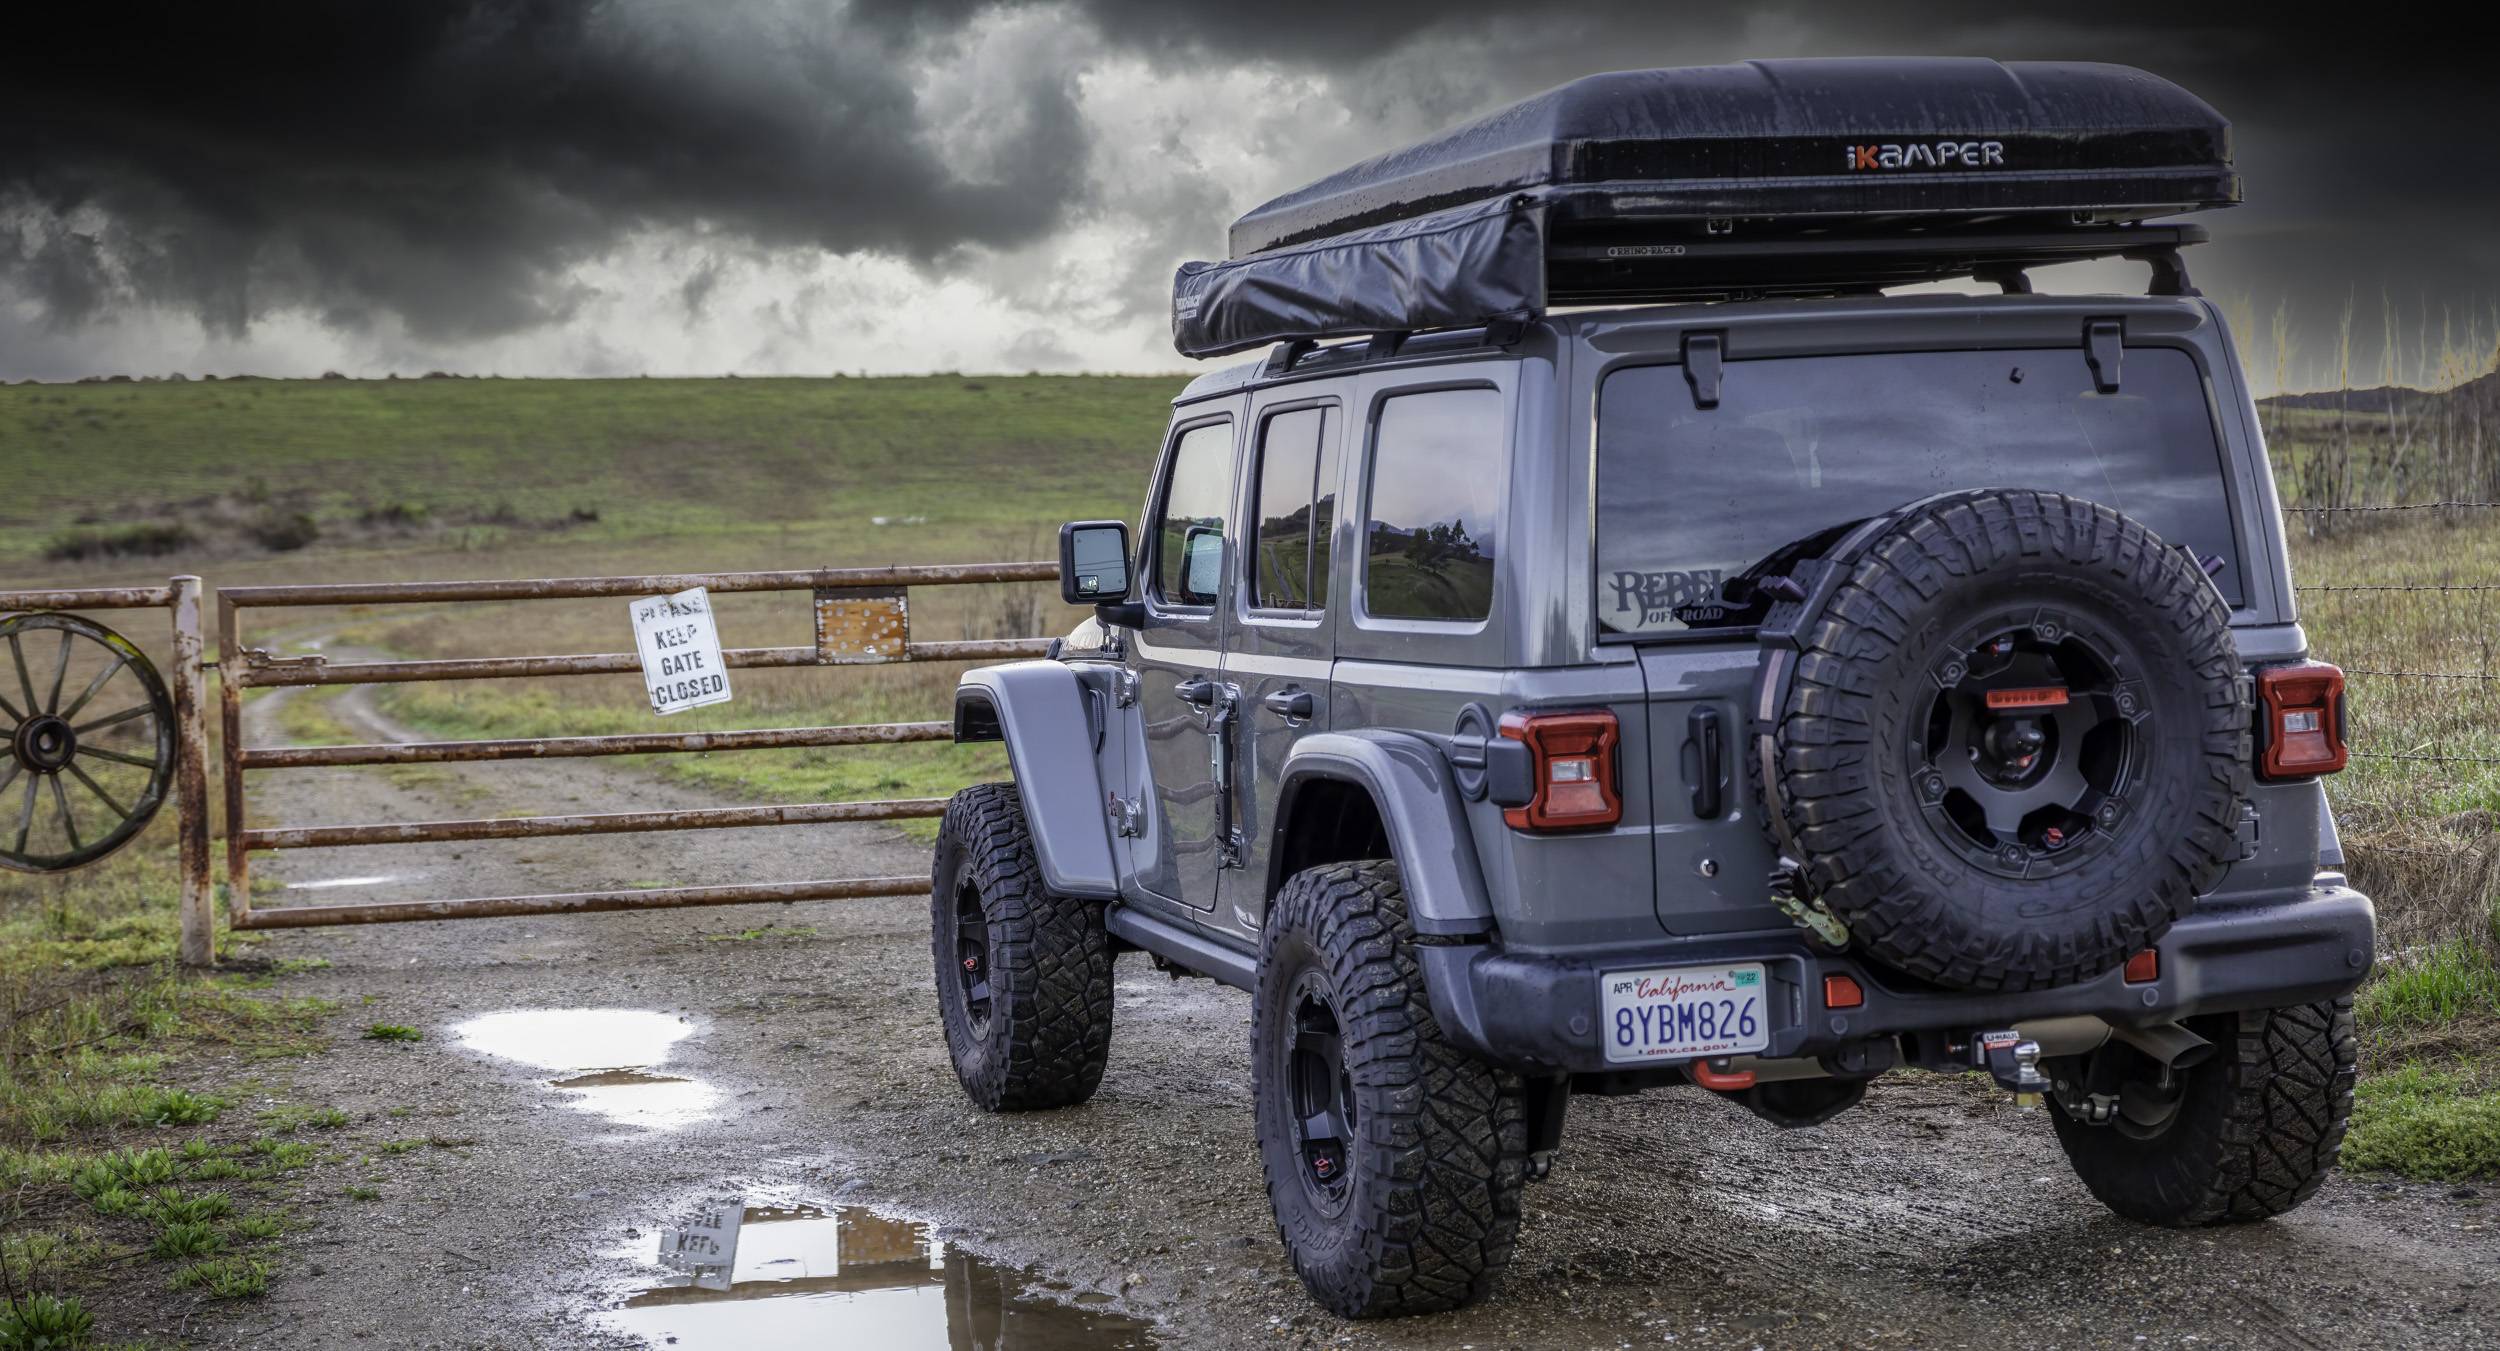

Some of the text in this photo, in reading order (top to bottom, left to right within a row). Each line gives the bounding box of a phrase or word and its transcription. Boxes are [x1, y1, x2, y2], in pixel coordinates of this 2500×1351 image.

[1617, 246, 1677, 256] RHINO-RACK
[1608, 569, 1750, 628] REBEL
[1649, 607, 1723, 624] OFF ROAD
[661, 651, 704, 676] GATE
[655, 674, 723, 705] CLOSED
[1613, 976, 1736, 1002] APR California
[1616, 997, 1757, 1047] 8YBM826
